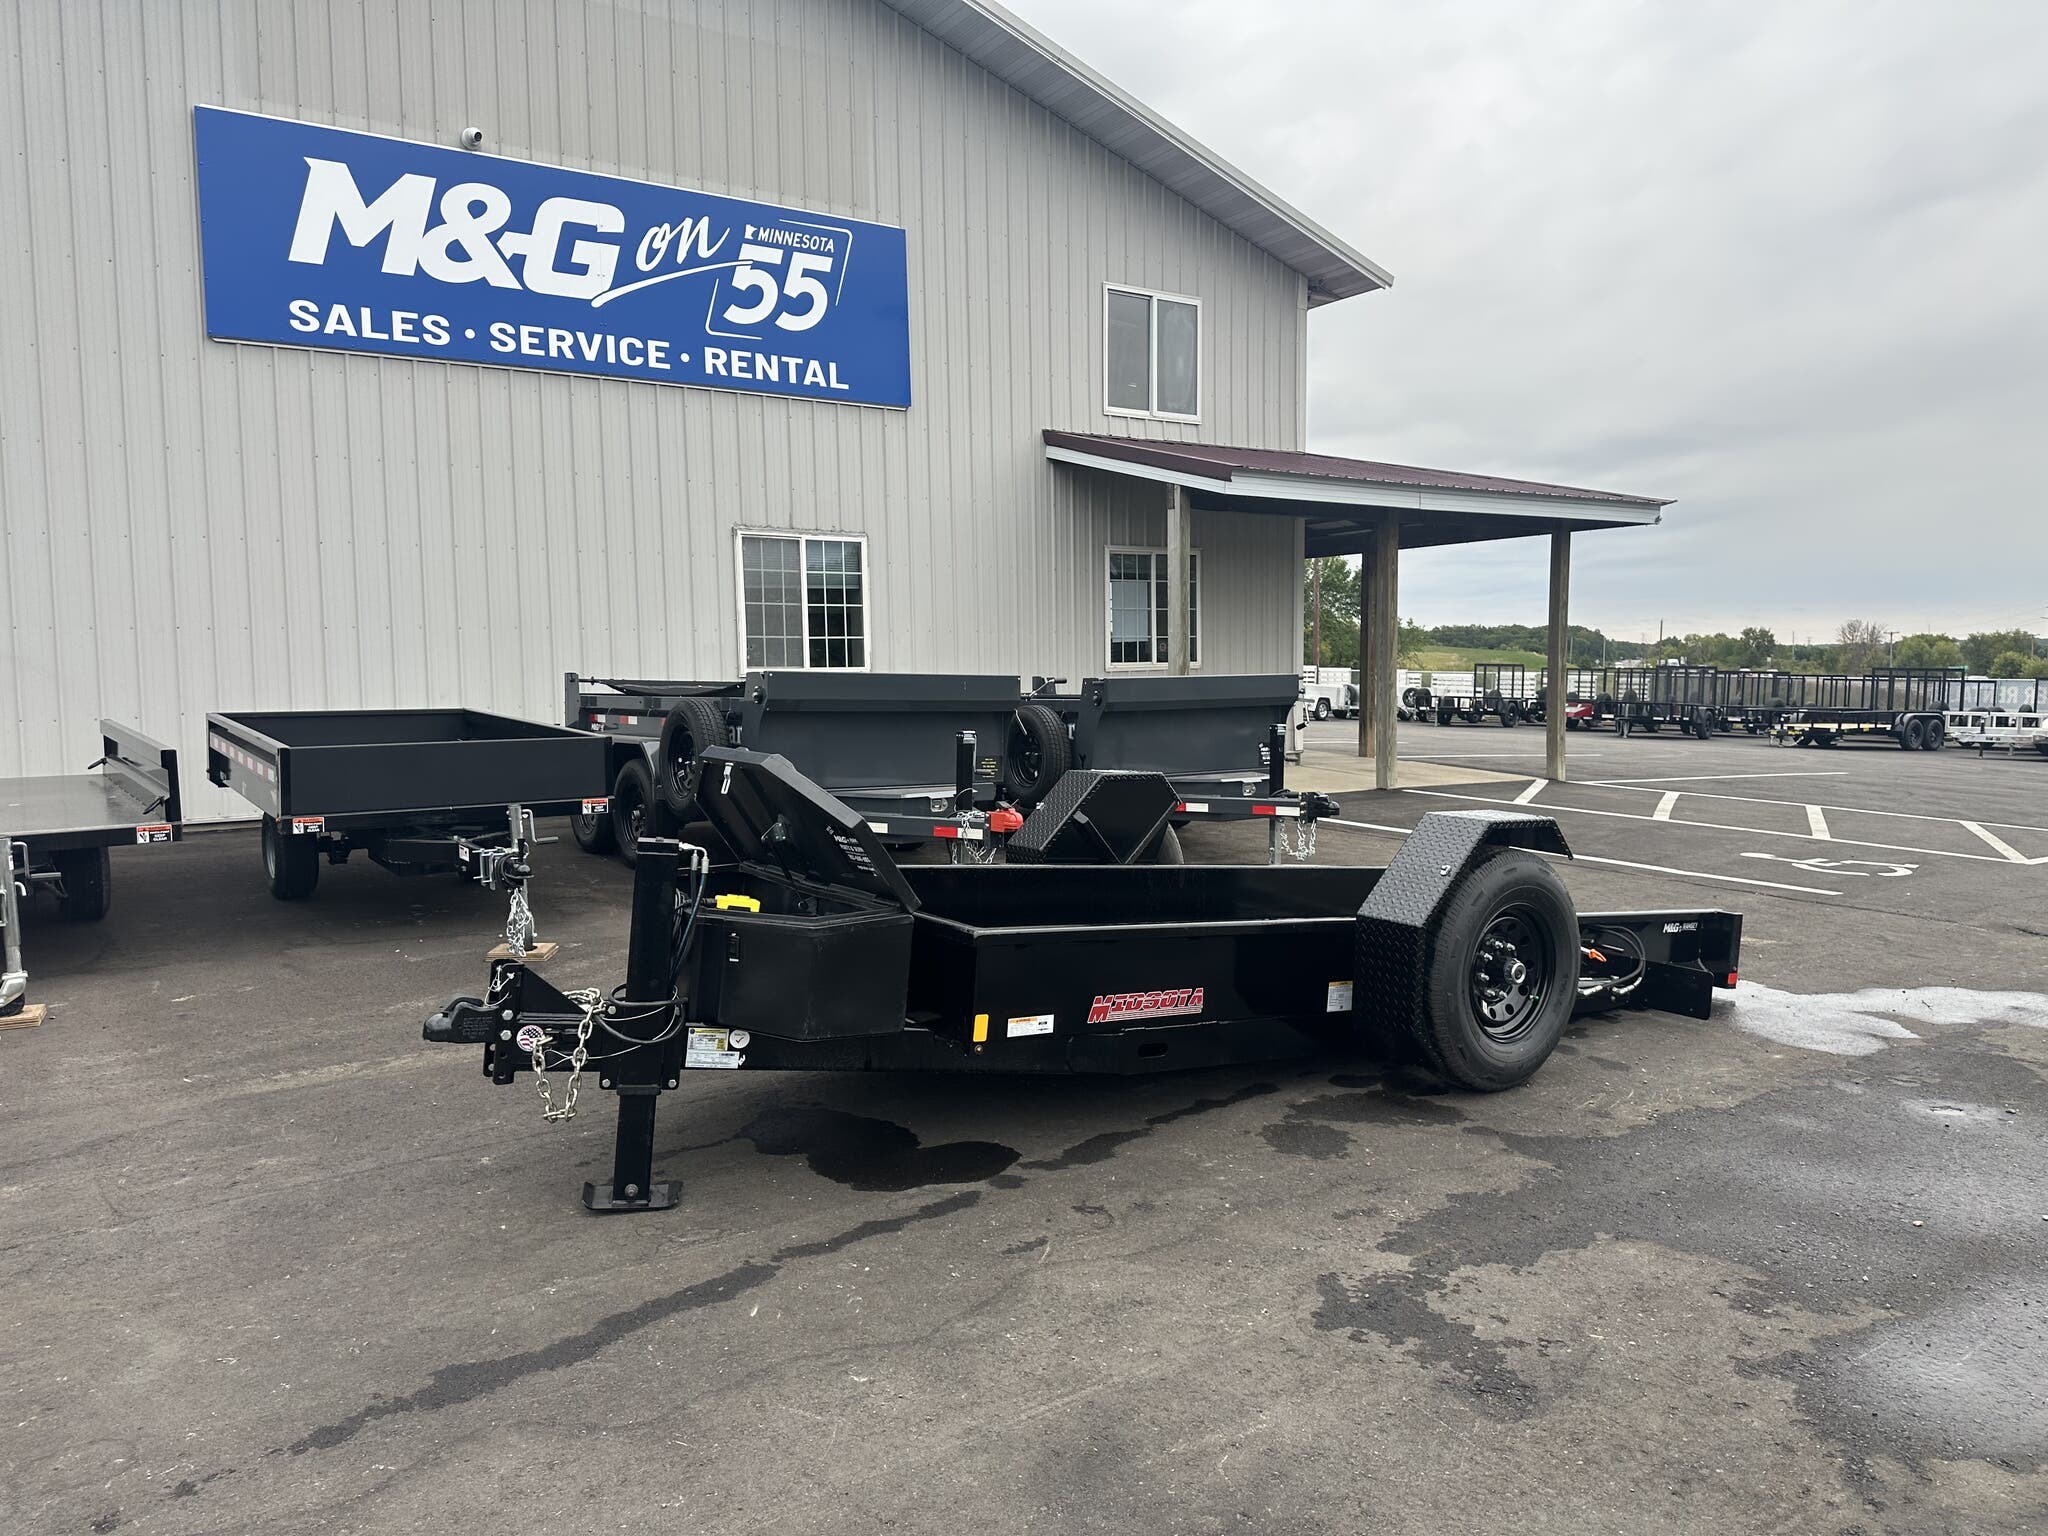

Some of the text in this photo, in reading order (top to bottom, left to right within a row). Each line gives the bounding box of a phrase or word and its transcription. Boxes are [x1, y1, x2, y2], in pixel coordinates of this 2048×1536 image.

[288, 156, 730, 300] M&G on
[756, 228, 836, 253] MINNESOTA
[722, 245, 833, 332] 55
[288, 299, 850, 391] SALES SERVICE RENTAL
[1087, 988, 1204, 1024] MIDSOTA
